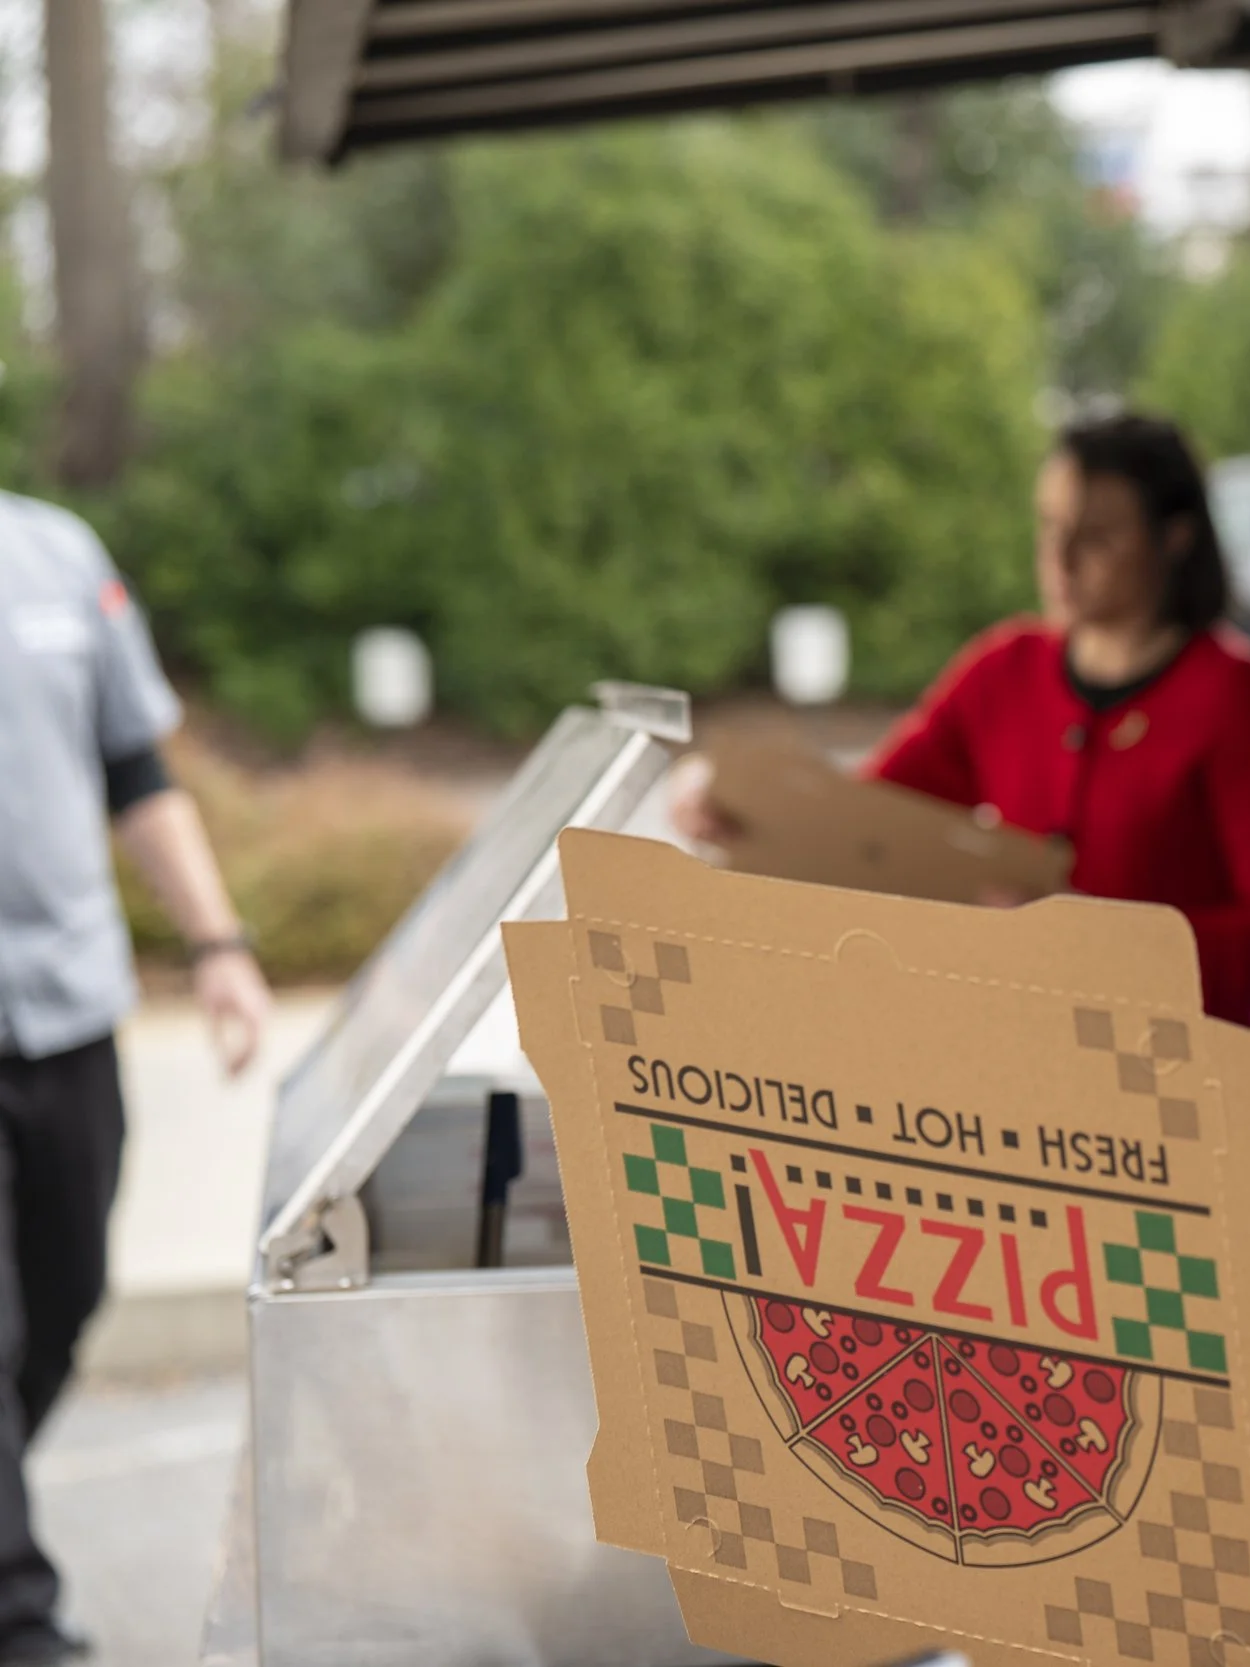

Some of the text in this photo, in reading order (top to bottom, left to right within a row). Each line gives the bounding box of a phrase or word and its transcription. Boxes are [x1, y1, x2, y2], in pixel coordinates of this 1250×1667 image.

[627, 1054, 1169, 1186] FRESH HOT DELICIOUS
[730, 1148, 1099, 1342] PIZZA!
